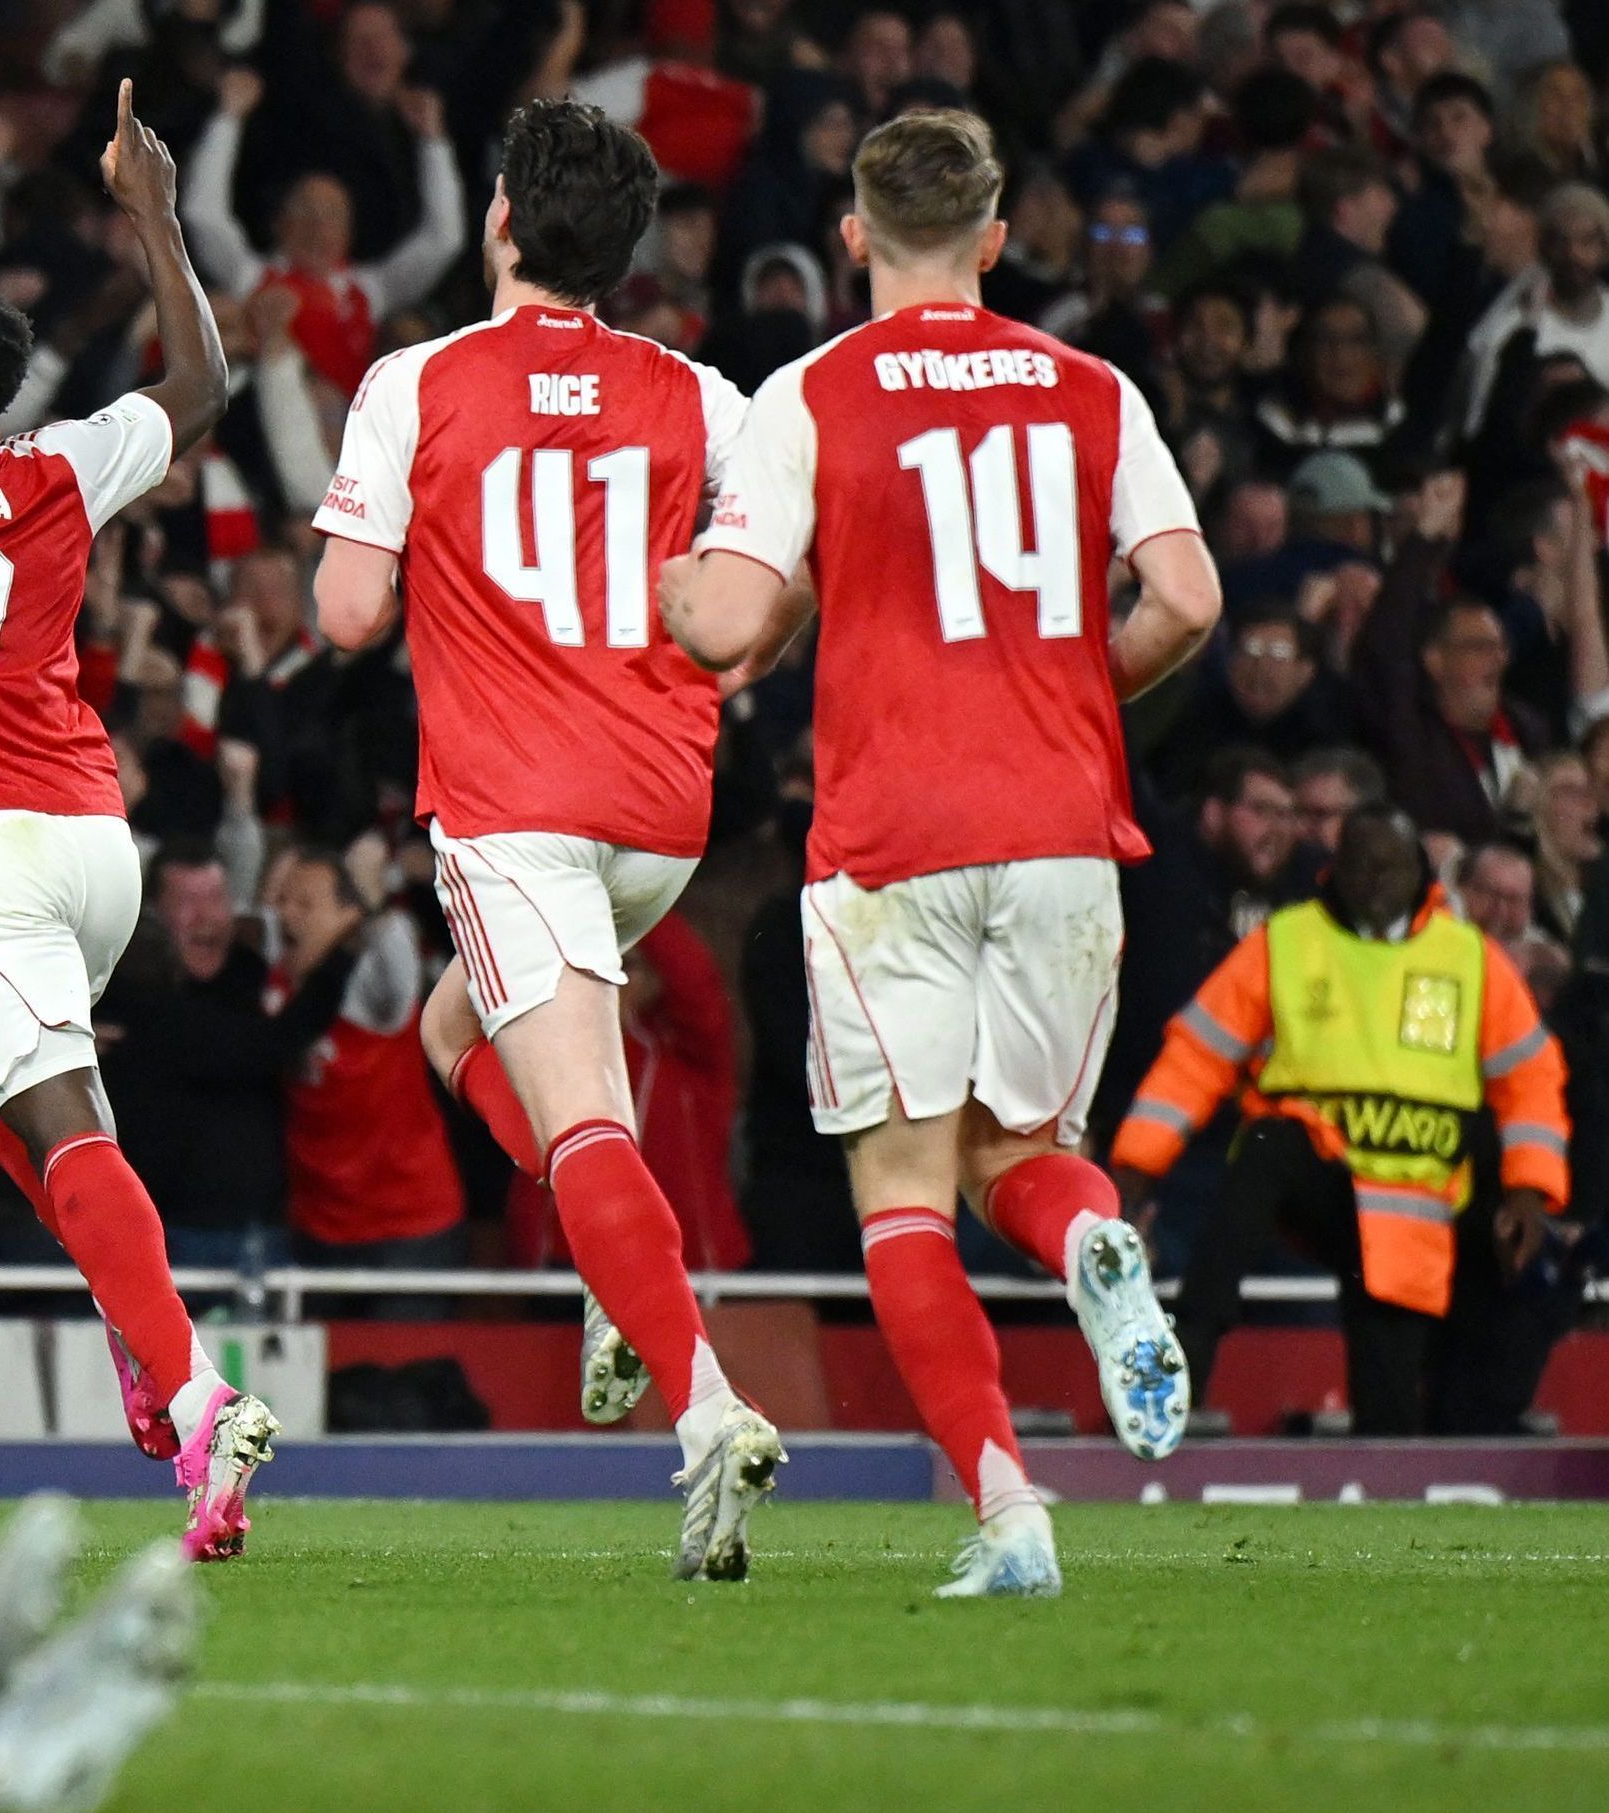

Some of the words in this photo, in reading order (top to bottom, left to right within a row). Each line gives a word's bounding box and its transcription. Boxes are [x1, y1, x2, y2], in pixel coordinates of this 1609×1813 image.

[527, 372, 602, 417] RICE
[873, 348, 1059, 392] GYÖKERES
[481, 446, 650, 649] 41
[896, 421, 1083, 643] 14
[1339, 1095, 1462, 1159] WARD
